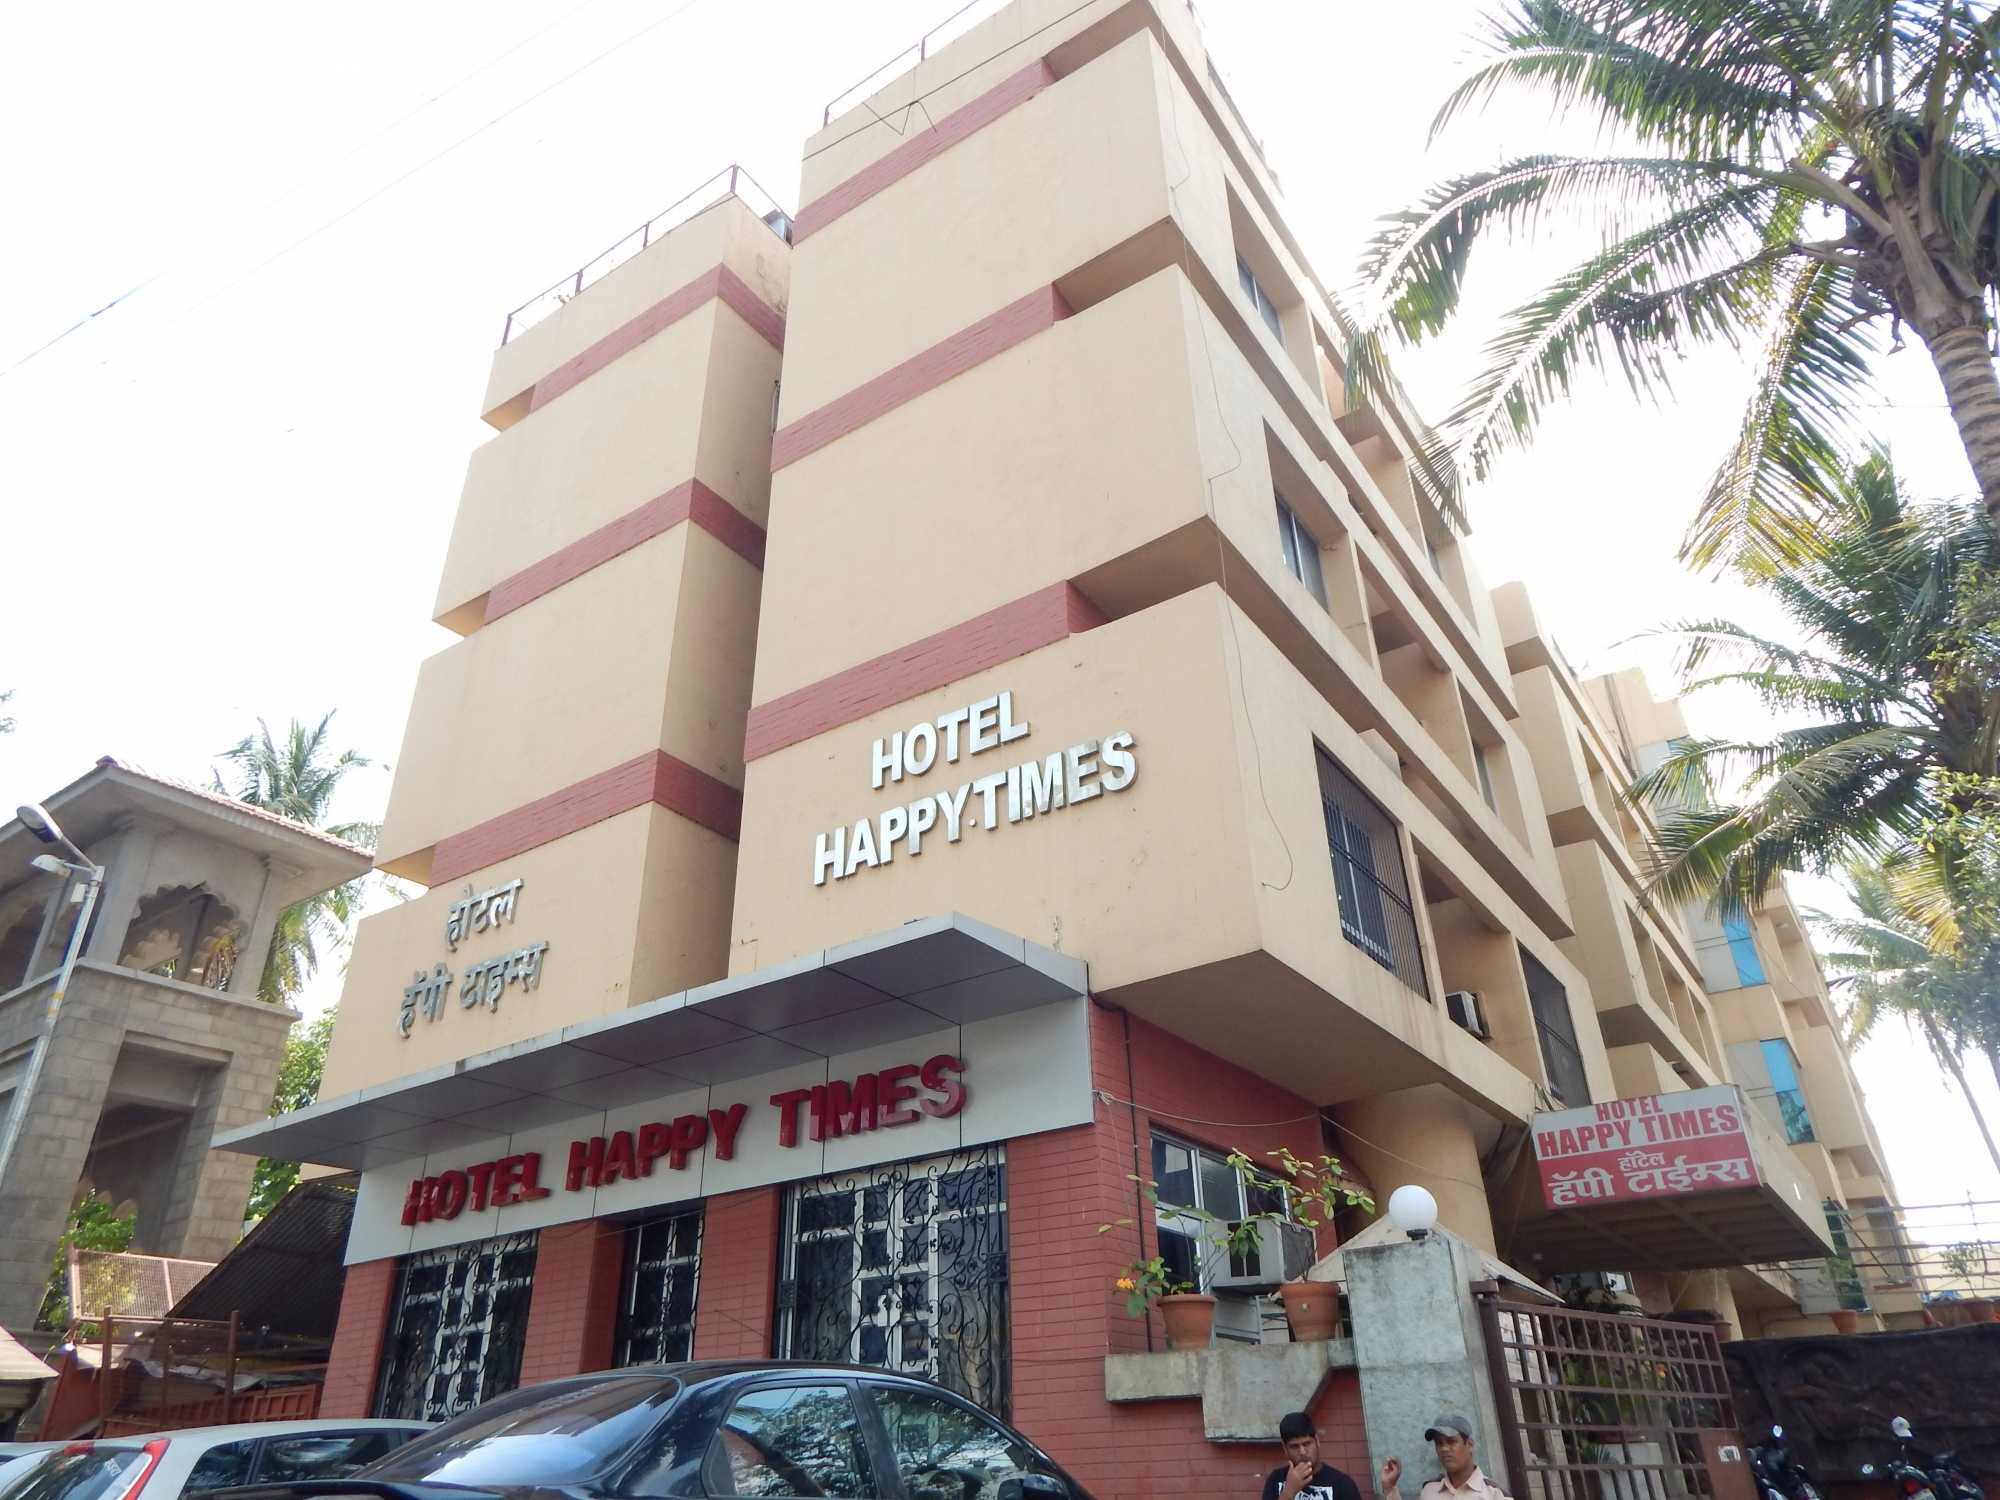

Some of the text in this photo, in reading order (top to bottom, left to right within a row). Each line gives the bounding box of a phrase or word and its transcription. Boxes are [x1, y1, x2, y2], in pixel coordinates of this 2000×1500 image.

[871, 689, 1031, 790] HOTEL
[400, 1054, 967, 1227] HOTEL HAPPY TIMES
[1537, 1104, 1740, 1158] HAPPY TIMES
[1595, 1096, 1663, 1121] HOTEL
